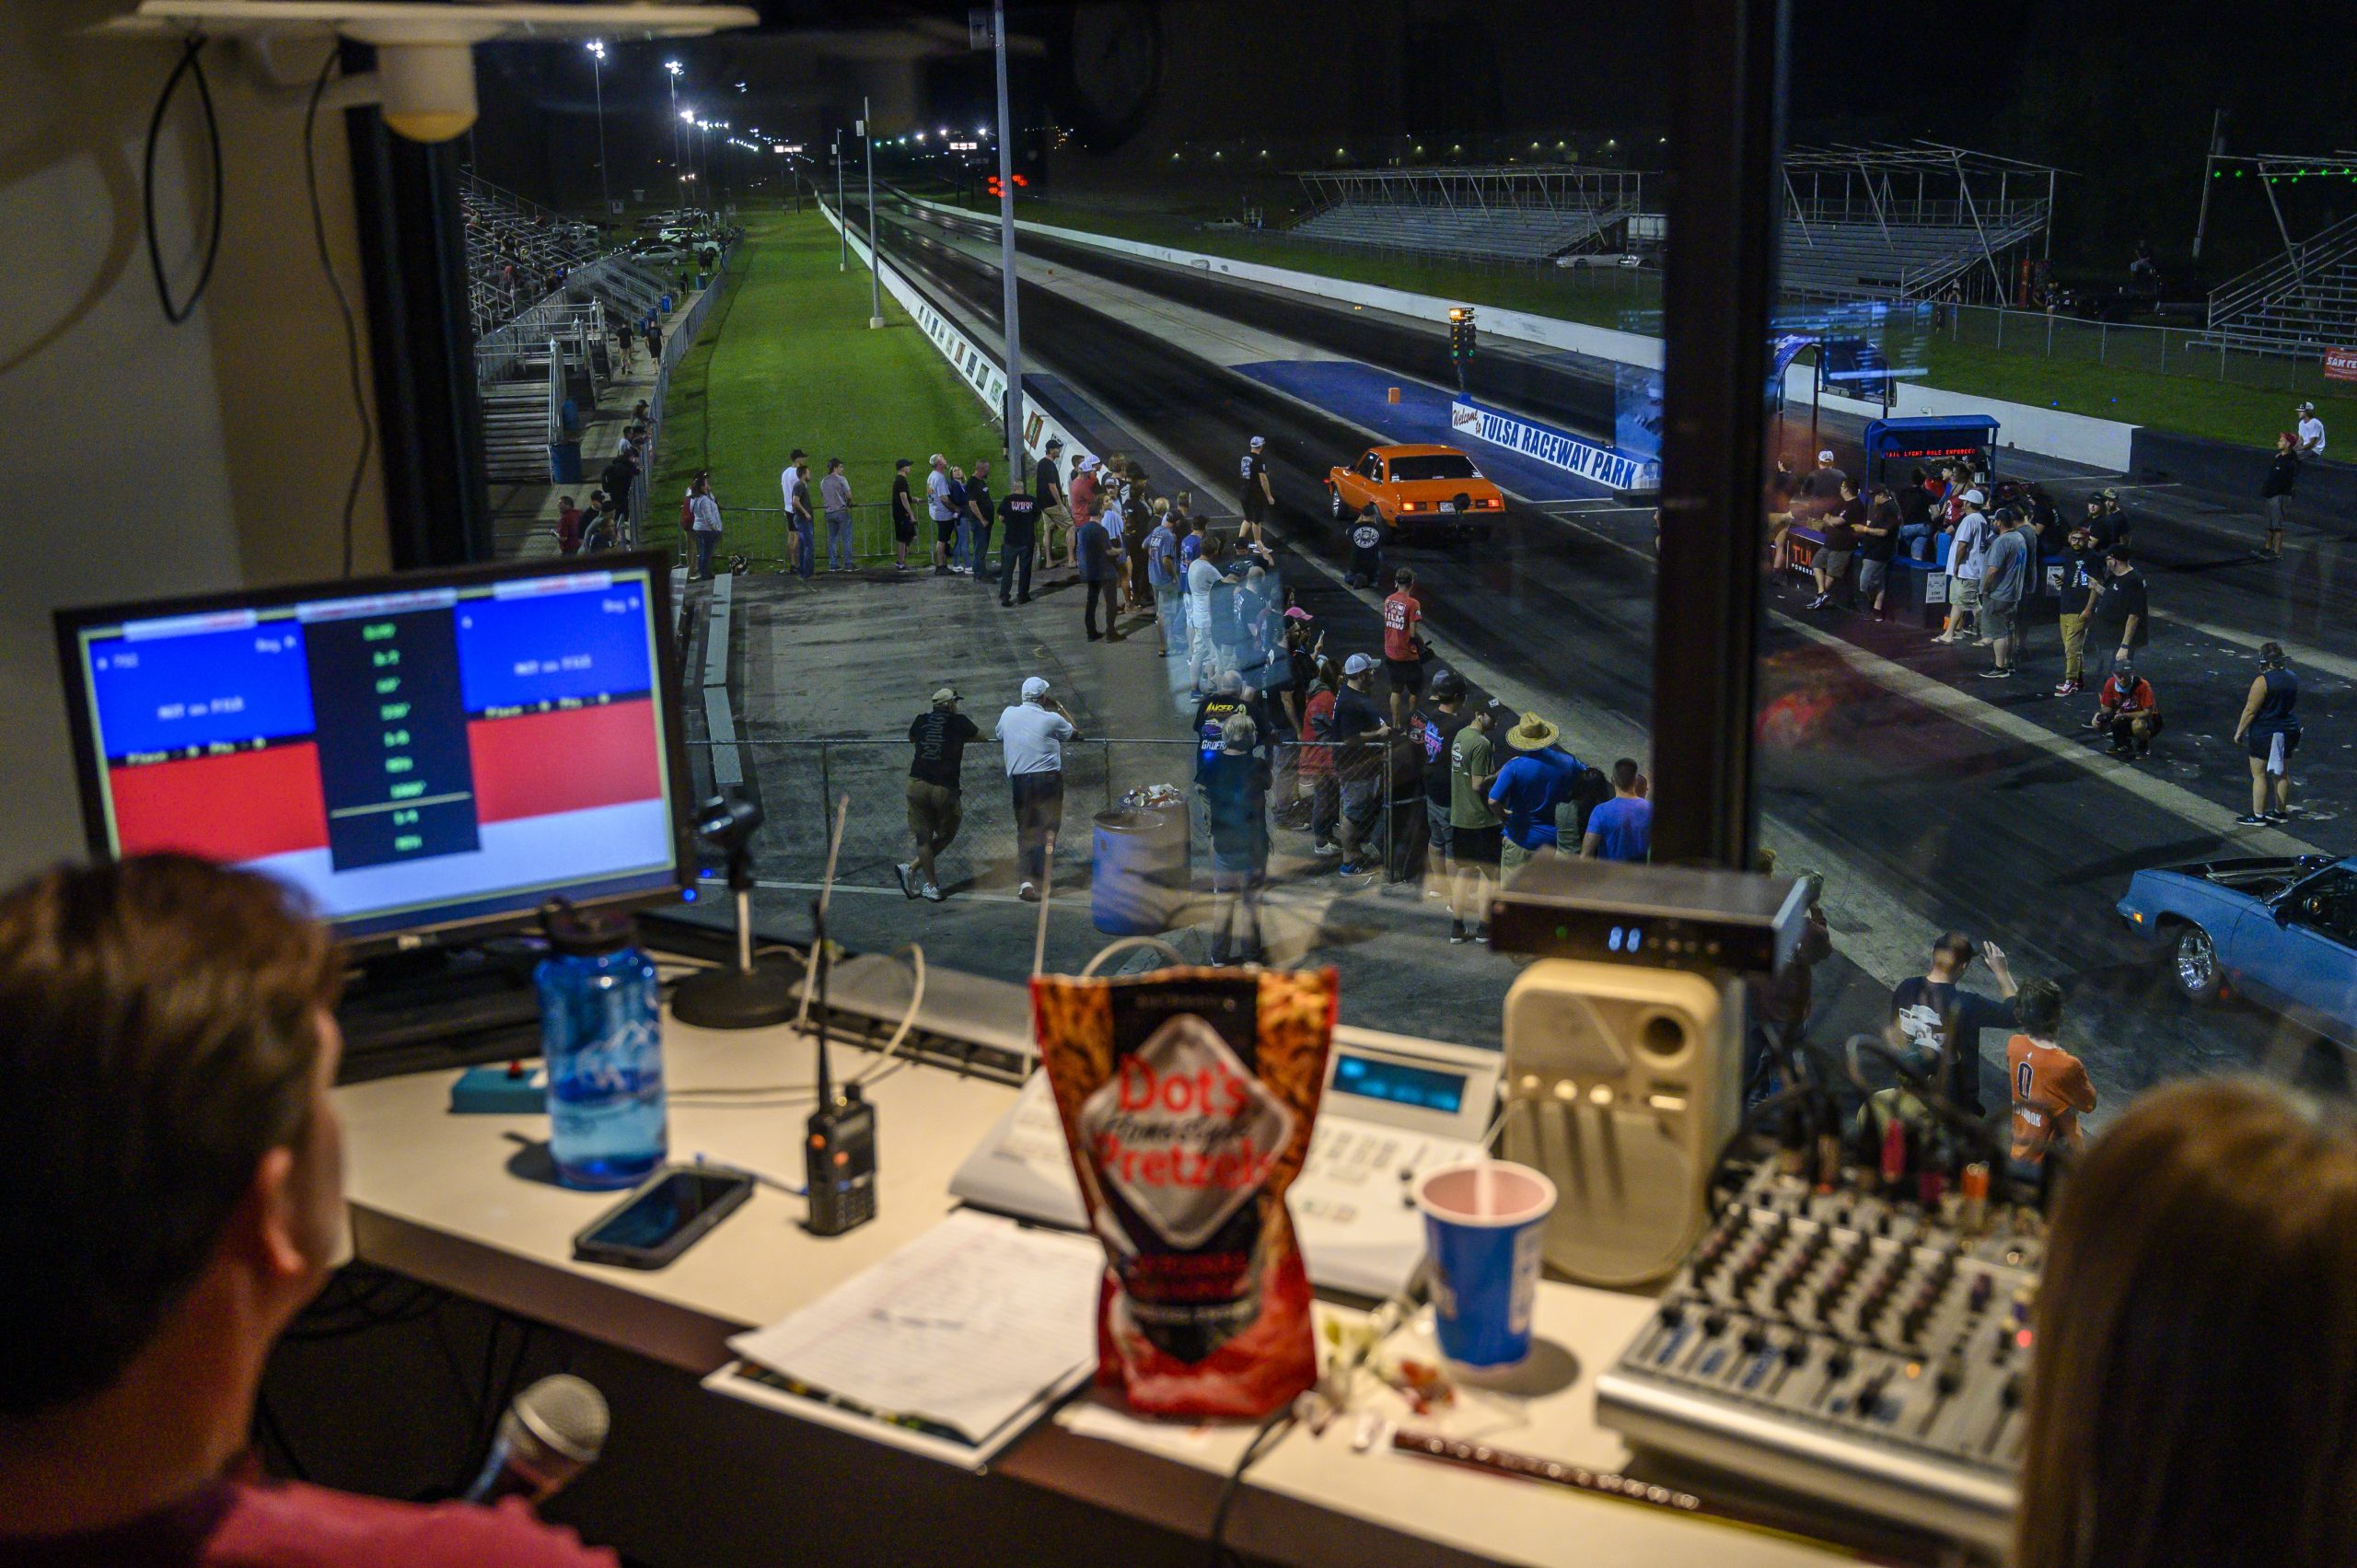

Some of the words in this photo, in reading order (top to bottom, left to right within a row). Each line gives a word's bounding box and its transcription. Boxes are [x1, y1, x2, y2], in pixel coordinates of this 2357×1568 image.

[1453, 406, 1479, 427] Welcome
[1475, 421, 1482, 435] to
[1481, 414, 1520, 447] TULSA
[1521, 427, 1592, 472] RACEWAY
[1591, 450, 1638, 488] PARK
[1119, 1052, 1247, 1117] Dot's
[2016, 1061, 2034, 1102] 0
